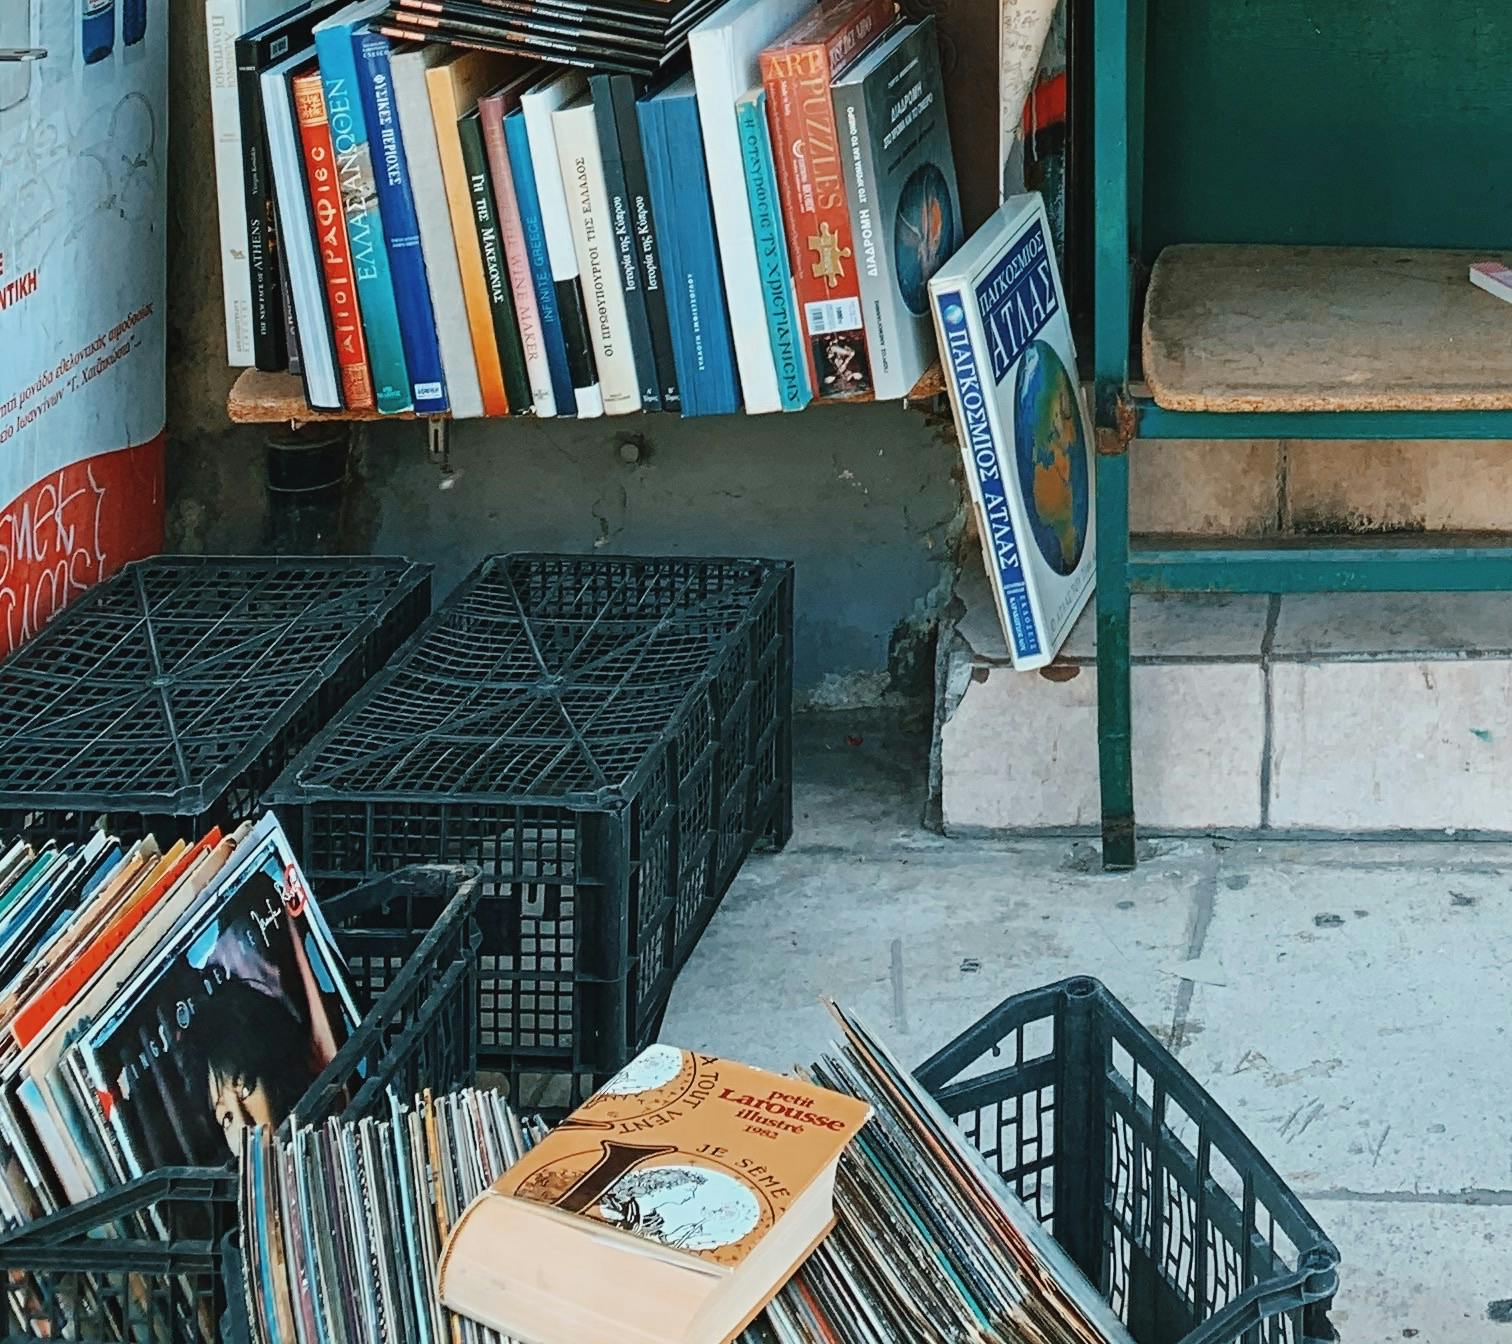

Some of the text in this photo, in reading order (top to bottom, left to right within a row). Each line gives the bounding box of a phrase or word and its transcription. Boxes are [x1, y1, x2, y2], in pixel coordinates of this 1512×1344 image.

[765, 50, 820, 81] ART
[373, 73, 402, 186] ΦΥΣΙΚΕΣ ΠΕΡΙΟΧΕΣ
[807, 77, 843, 210] PUZZLES
[573, 156, 592, 215] ΕΛΛΑΔΟΣ
[585, 217, 597, 246] ΤΗΣ
[612, 195, 626, 234] Κύπρου
[634, 195, 649, 234] Κύπρου
[249, 218, 263, 272] ATHENS
[526, 215, 556, 324] INFINITE GREECE
[866, 209, 879, 277] ΔΙΑΔΡΟΜΗ
[624, 252, 636, 292] Ιστορία
[645, 252, 659, 291] Ιστορία
[978, 230, 1045, 317] ΠΑΓΚΟΣΜΙΟΣ
[517, 302, 539, 362] MAKER
[990, 260, 1058, 378] ΑΤΛΑΣ
[948, 327, 1000, 483] ΠΑΓΚΟΣΜΙΟΣ
[984, 492, 1020, 570] ΑΤΛΑΣ
[618, 1070, 720, 1134] TOUT VENT
[717, 1087, 846, 1135] Larousse
[736, 1108, 804, 1135] illustré
[767, 1087, 815, 1110] petit
[744, 1124, 780, 1141] 1982
[697, 1143, 791, 1201] JE SÈME
